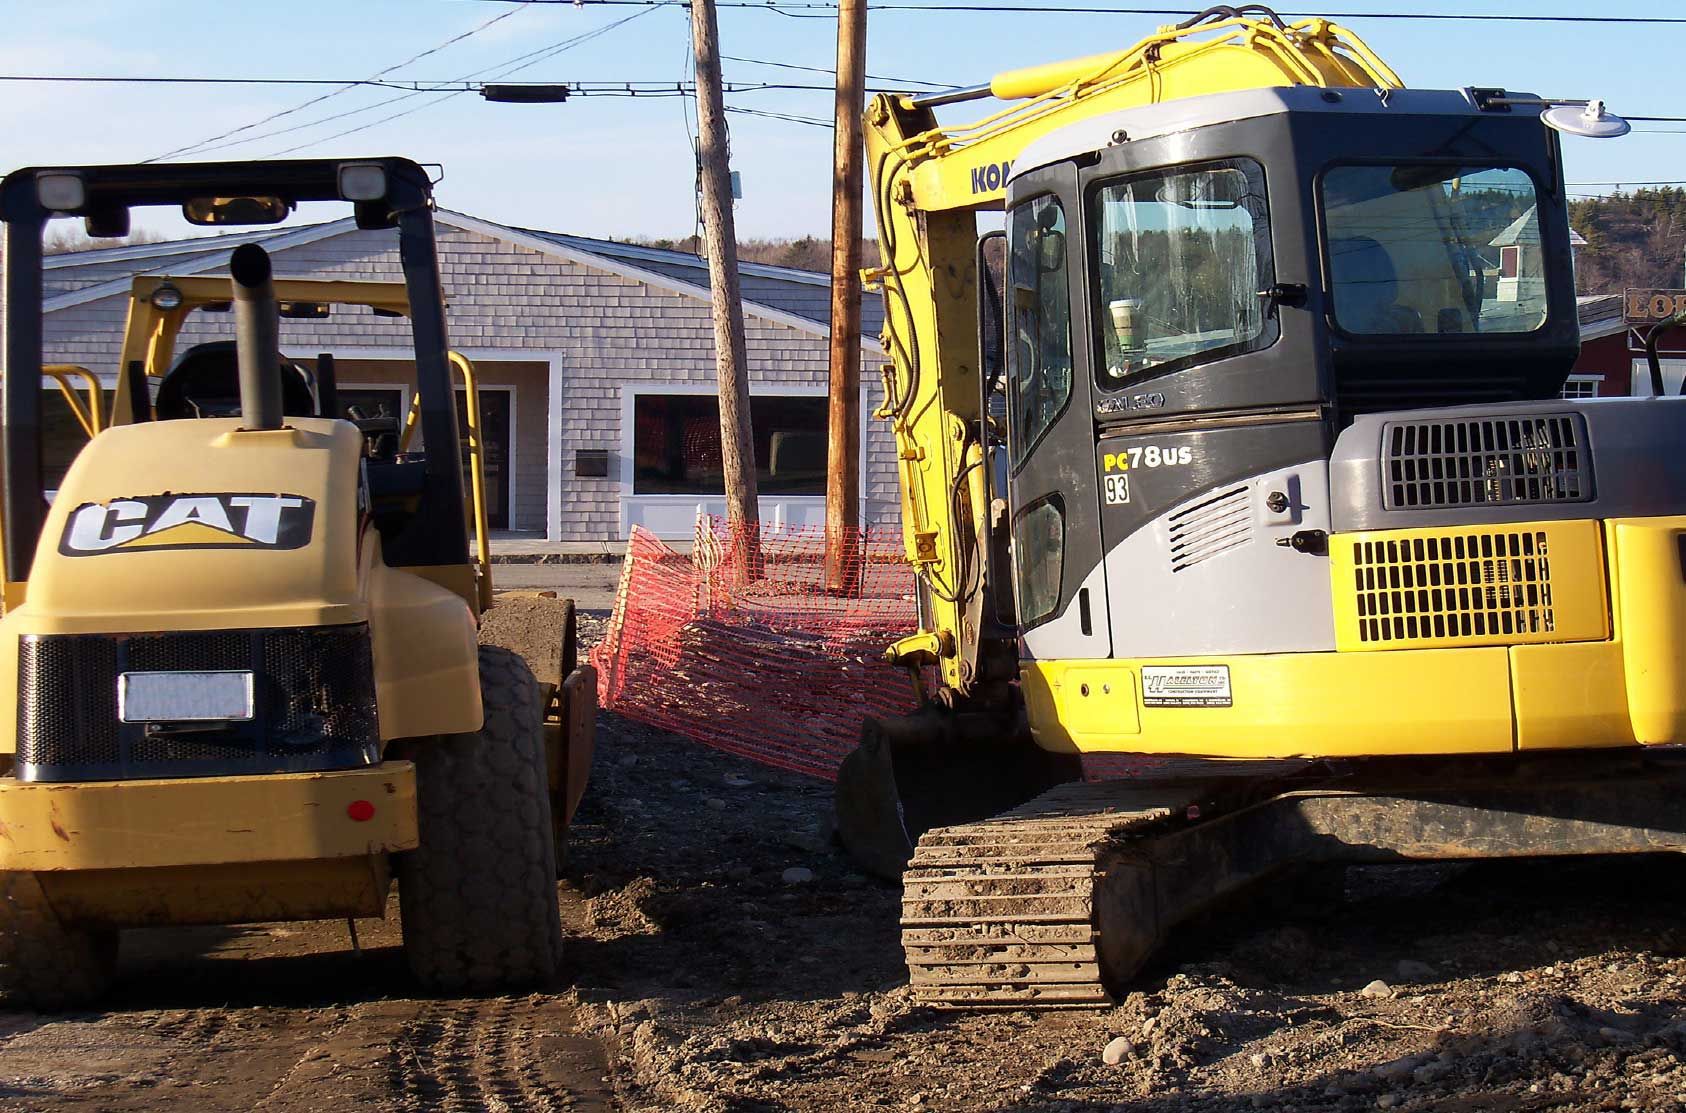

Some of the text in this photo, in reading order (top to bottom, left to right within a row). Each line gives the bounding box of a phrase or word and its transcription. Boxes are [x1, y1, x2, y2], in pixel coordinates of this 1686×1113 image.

[1103, 446, 1193, 472] PC78US
[1106, 476, 1128, 502] 93
[68, 497, 302, 551] CAT
